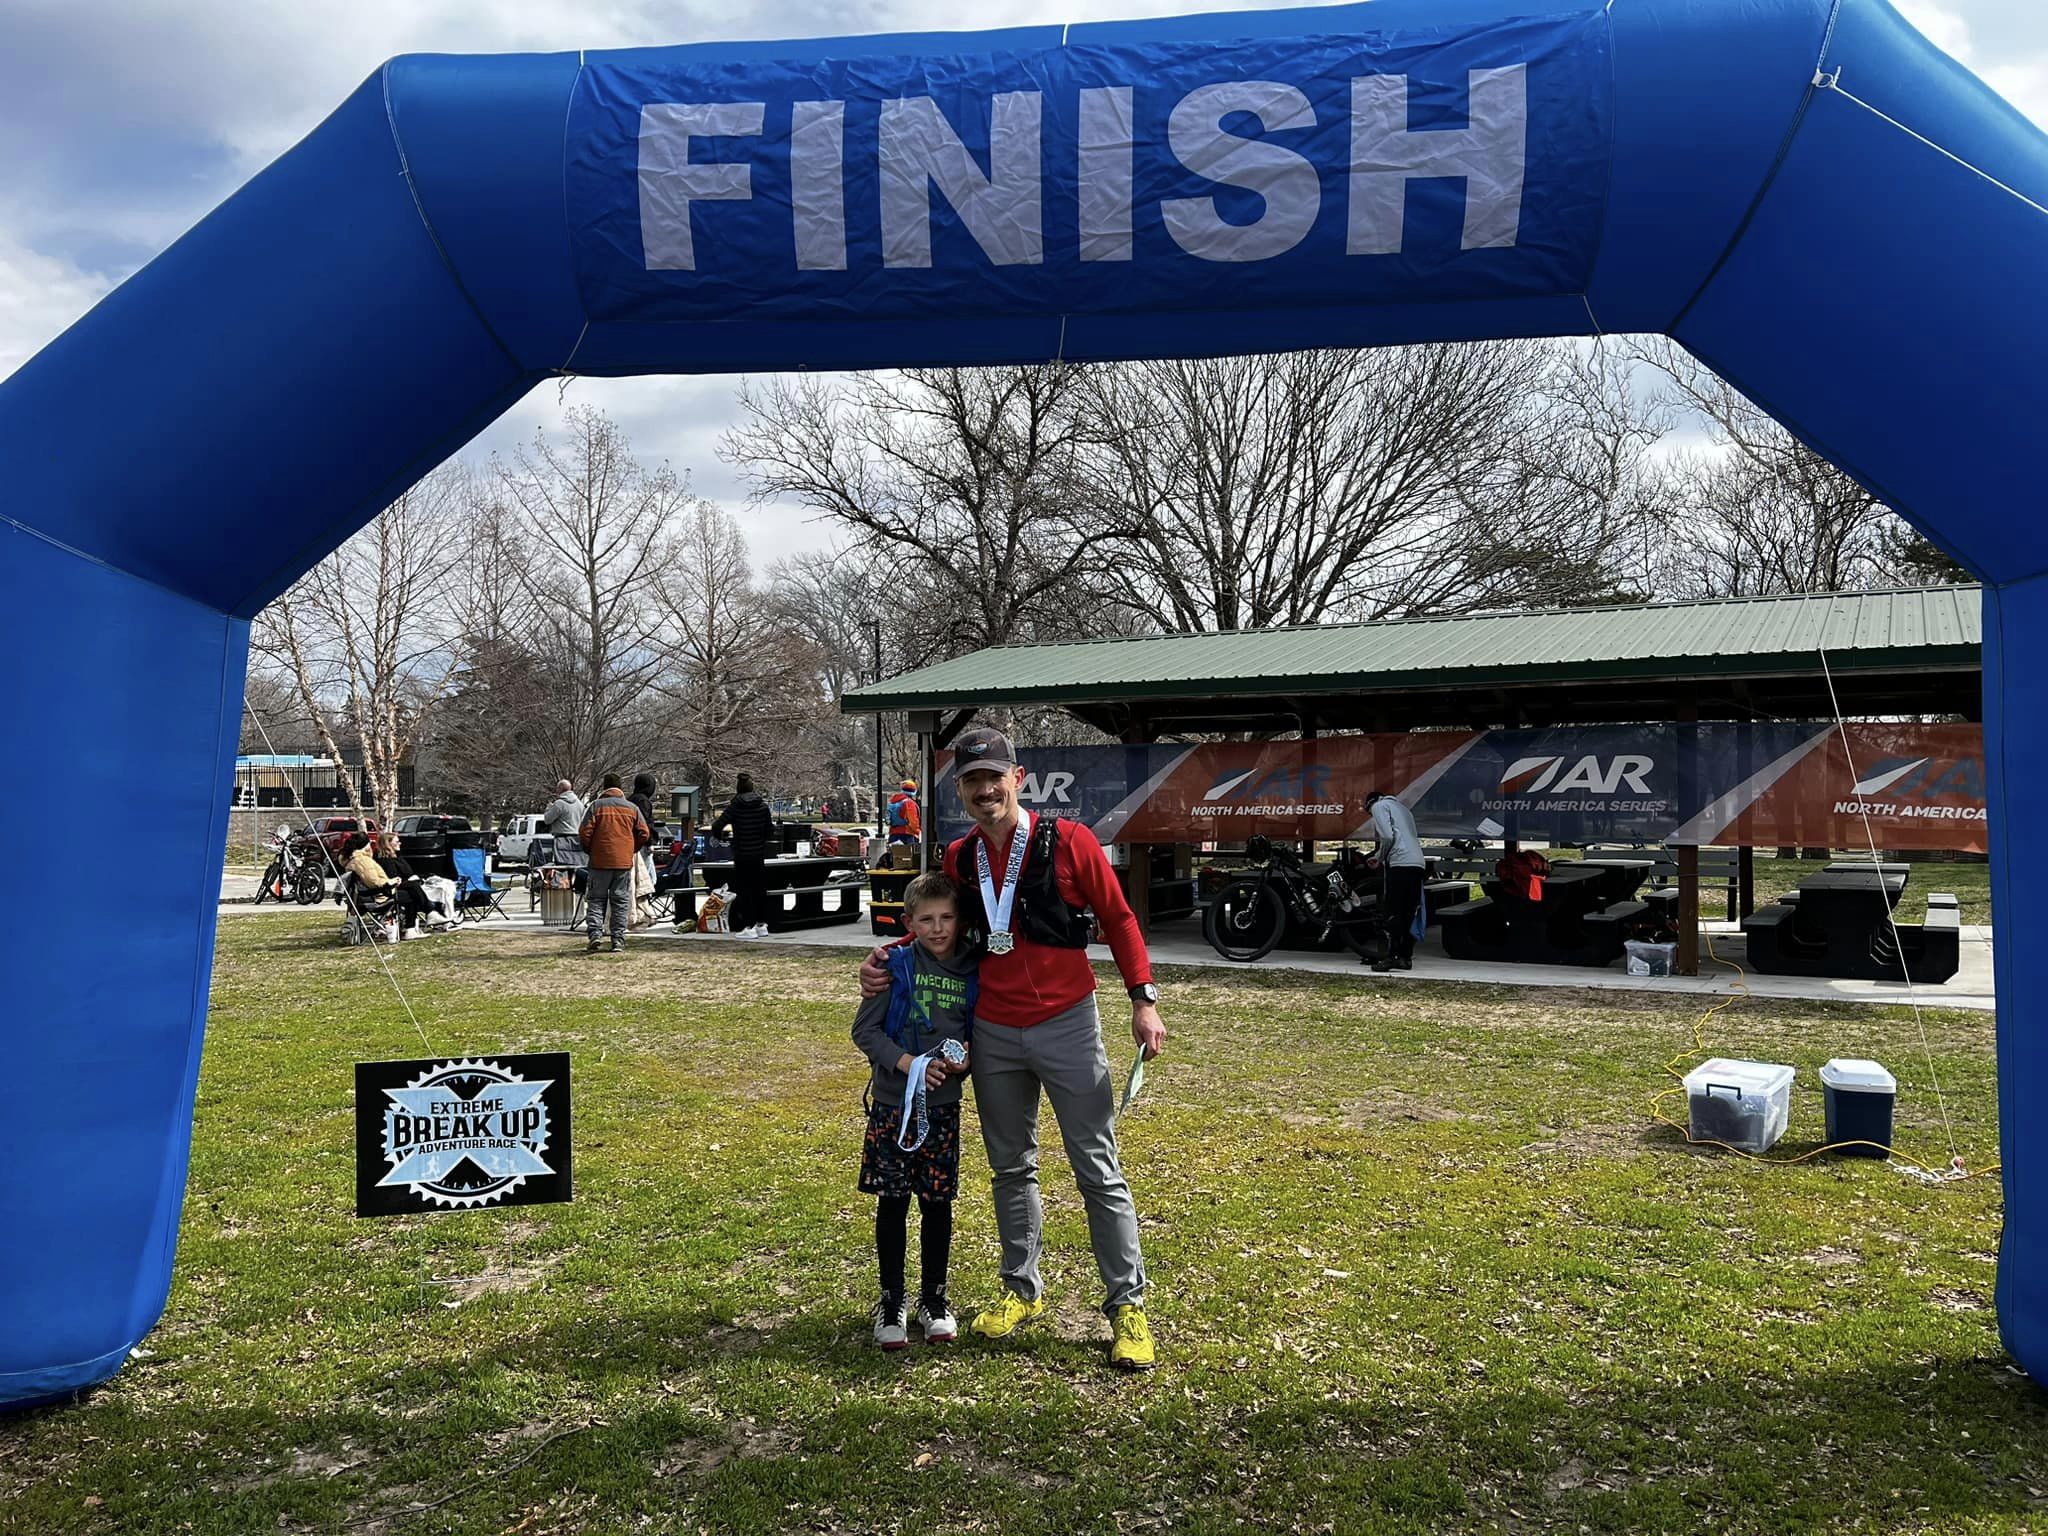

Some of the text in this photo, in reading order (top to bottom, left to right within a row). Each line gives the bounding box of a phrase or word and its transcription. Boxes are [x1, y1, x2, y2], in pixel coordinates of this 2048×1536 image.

[637, 62, 1529, 271] FINISH
[1550, 754, 1653, 794] AR
[1043, 807, 1081, 818] SERIES
[1191, 804, 1345, 816] NORTH AMERICA SERIES
[1481, 799, 1668, 812] NORTH AMERICA SERIES
[1833, 801, 1988, 821] NORTH AMERICA
[430, 1098, 504, 1115] EXTREME
[393, 1106, 541, 1149] BREAK UP
[418, 1138, 517, 1155] ADVENTURE RACE
